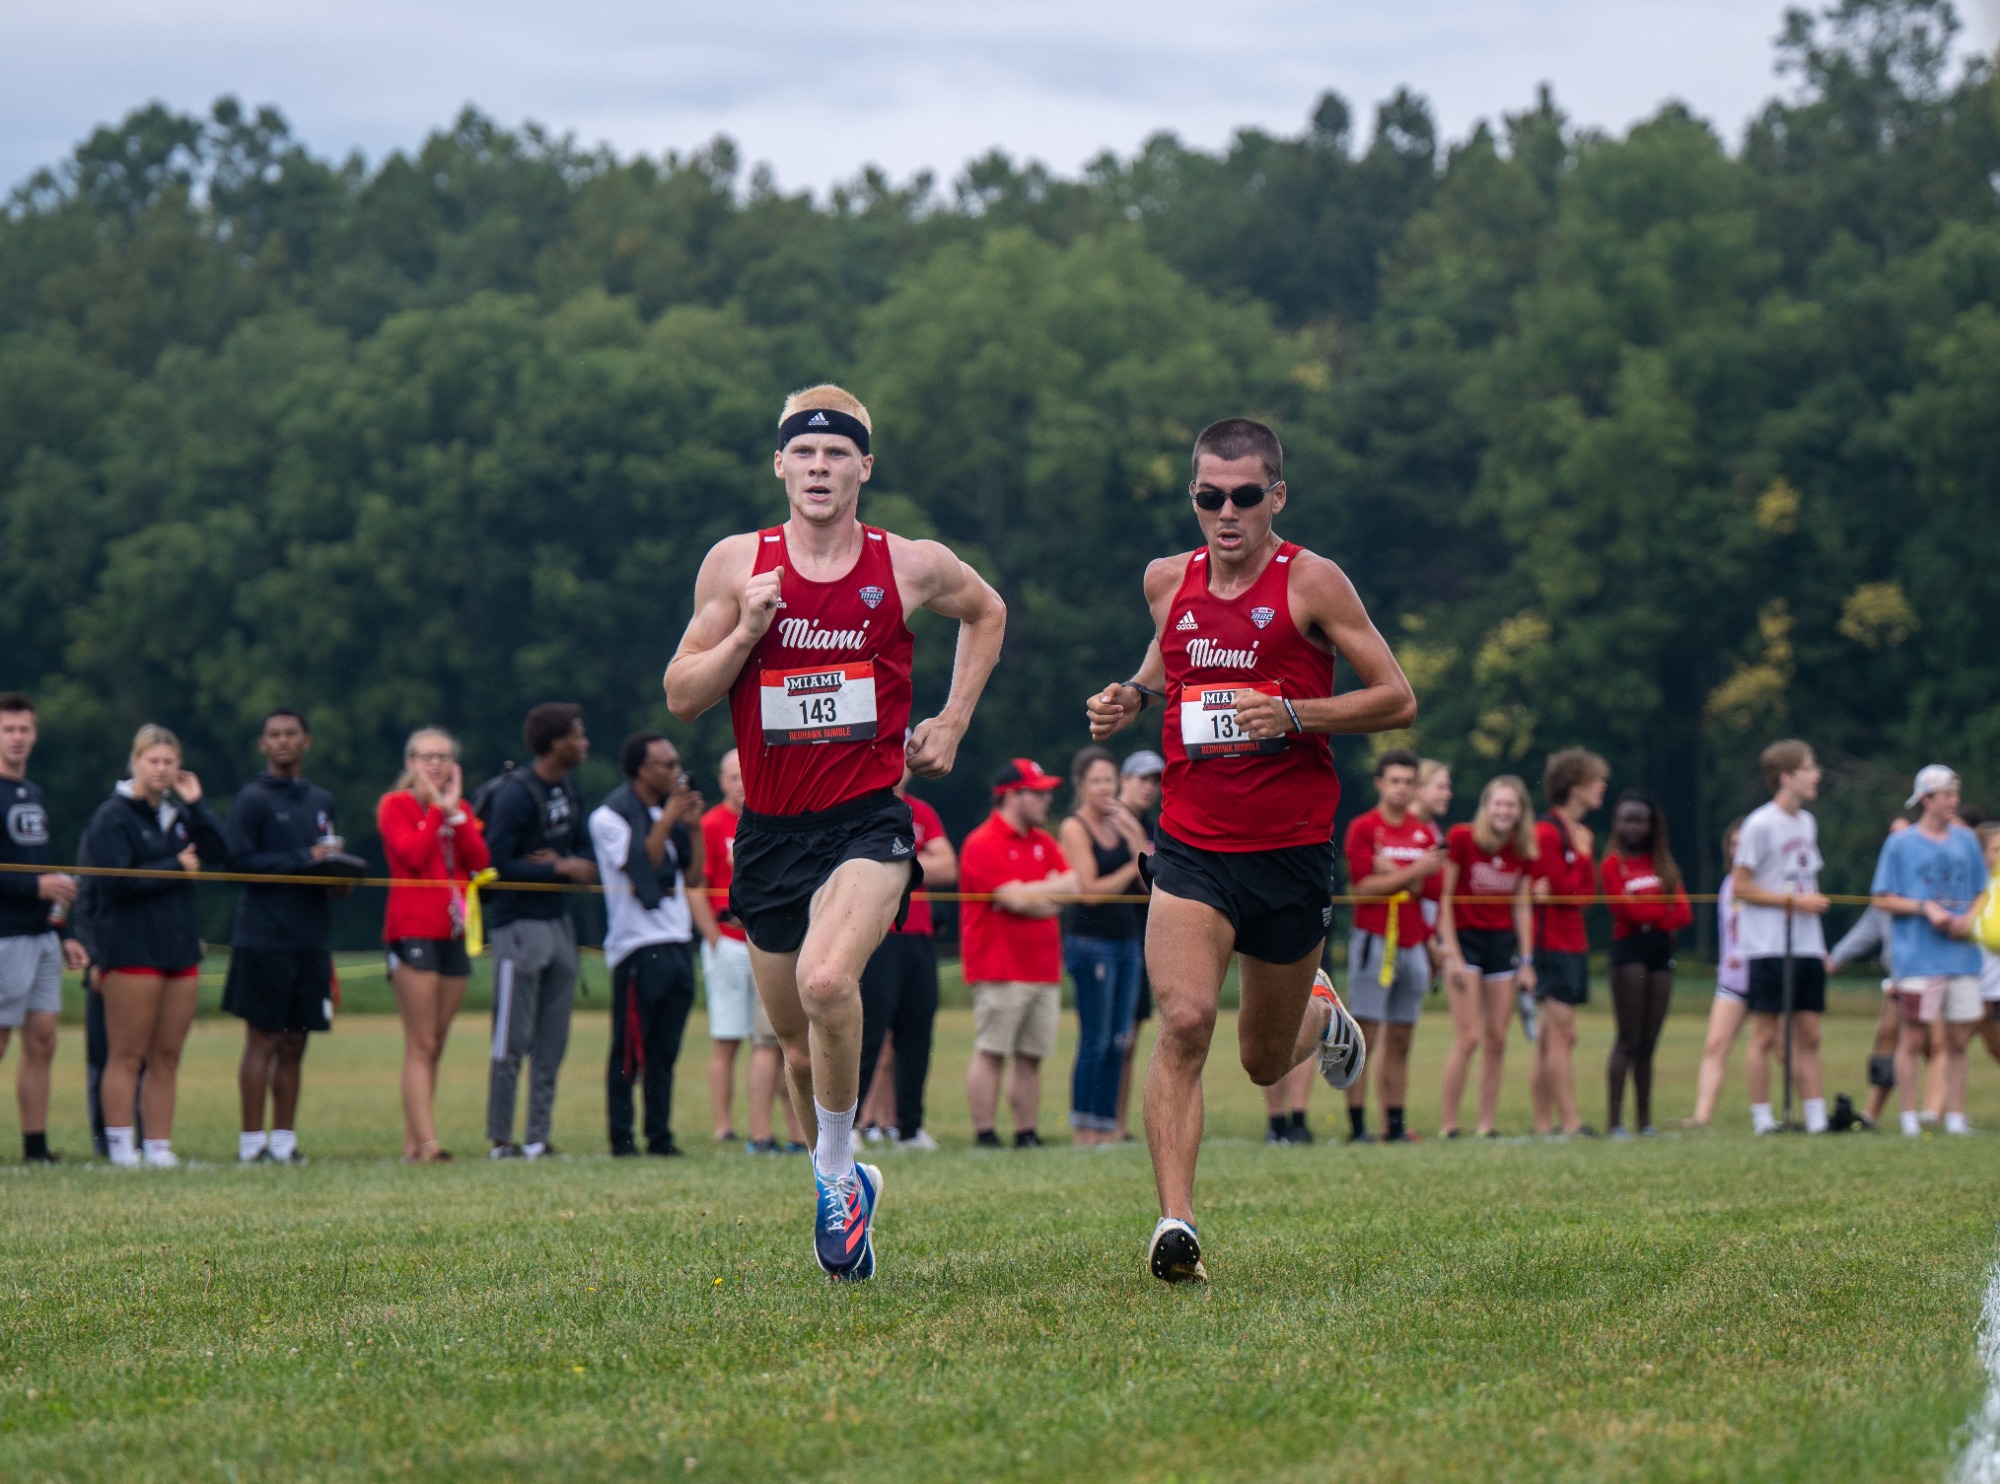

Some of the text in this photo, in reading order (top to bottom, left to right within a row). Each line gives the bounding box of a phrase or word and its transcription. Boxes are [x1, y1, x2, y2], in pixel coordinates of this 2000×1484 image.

[1251, 612, 1274, 620] MAC
[778, 617, 871, 650] Miami
[1176, 622, 1198, 631] adidas
[1185, 638, 1260, 669] Miami
[789, 673, 840, 689] MIAMI
[1205, 691, 1236, 704] MIA
[799, 697, 837, 725] 143
[789, 726, 851, 740] REDHAWK RUMBLE
[1201, 744, 1234, 754] REDHAWK
